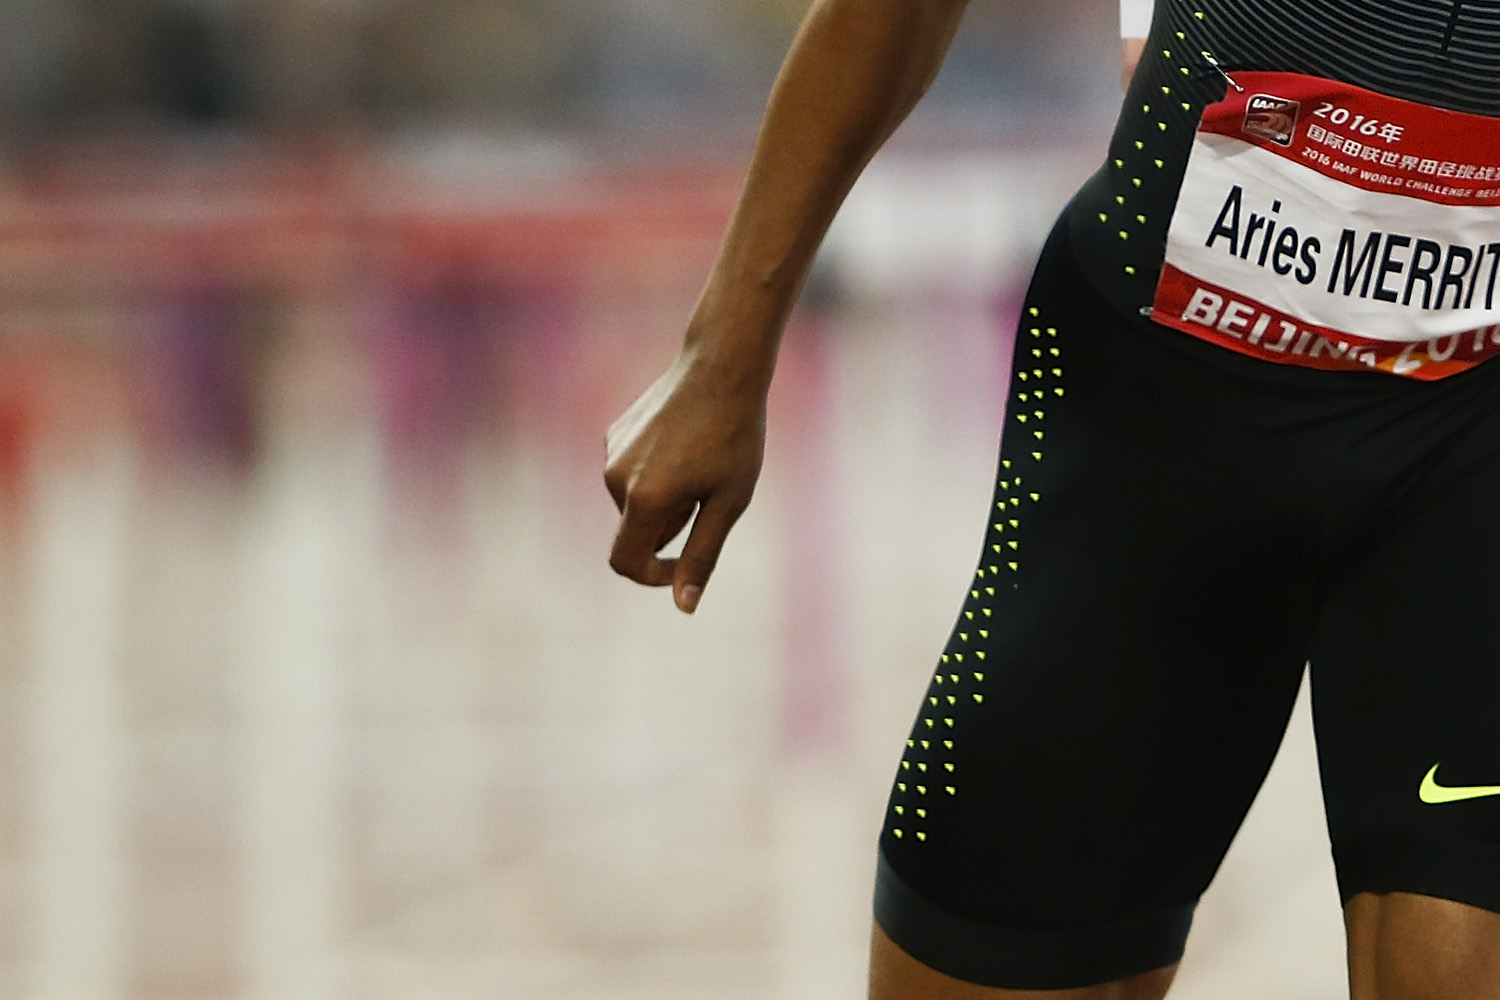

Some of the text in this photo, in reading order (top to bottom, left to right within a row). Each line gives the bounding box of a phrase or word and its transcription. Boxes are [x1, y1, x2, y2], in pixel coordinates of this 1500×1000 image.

[1312, 102, 1404, 143] 2016年
[1301, 147, 1331, 166] 2016
[1332, 160, 1359, 175] IAAF
[1360, 170, 1403, 187] WORLD
[1405, 179, 1473, 197] CHALLENGE
[1206, 185, 1321, 285] Aries
